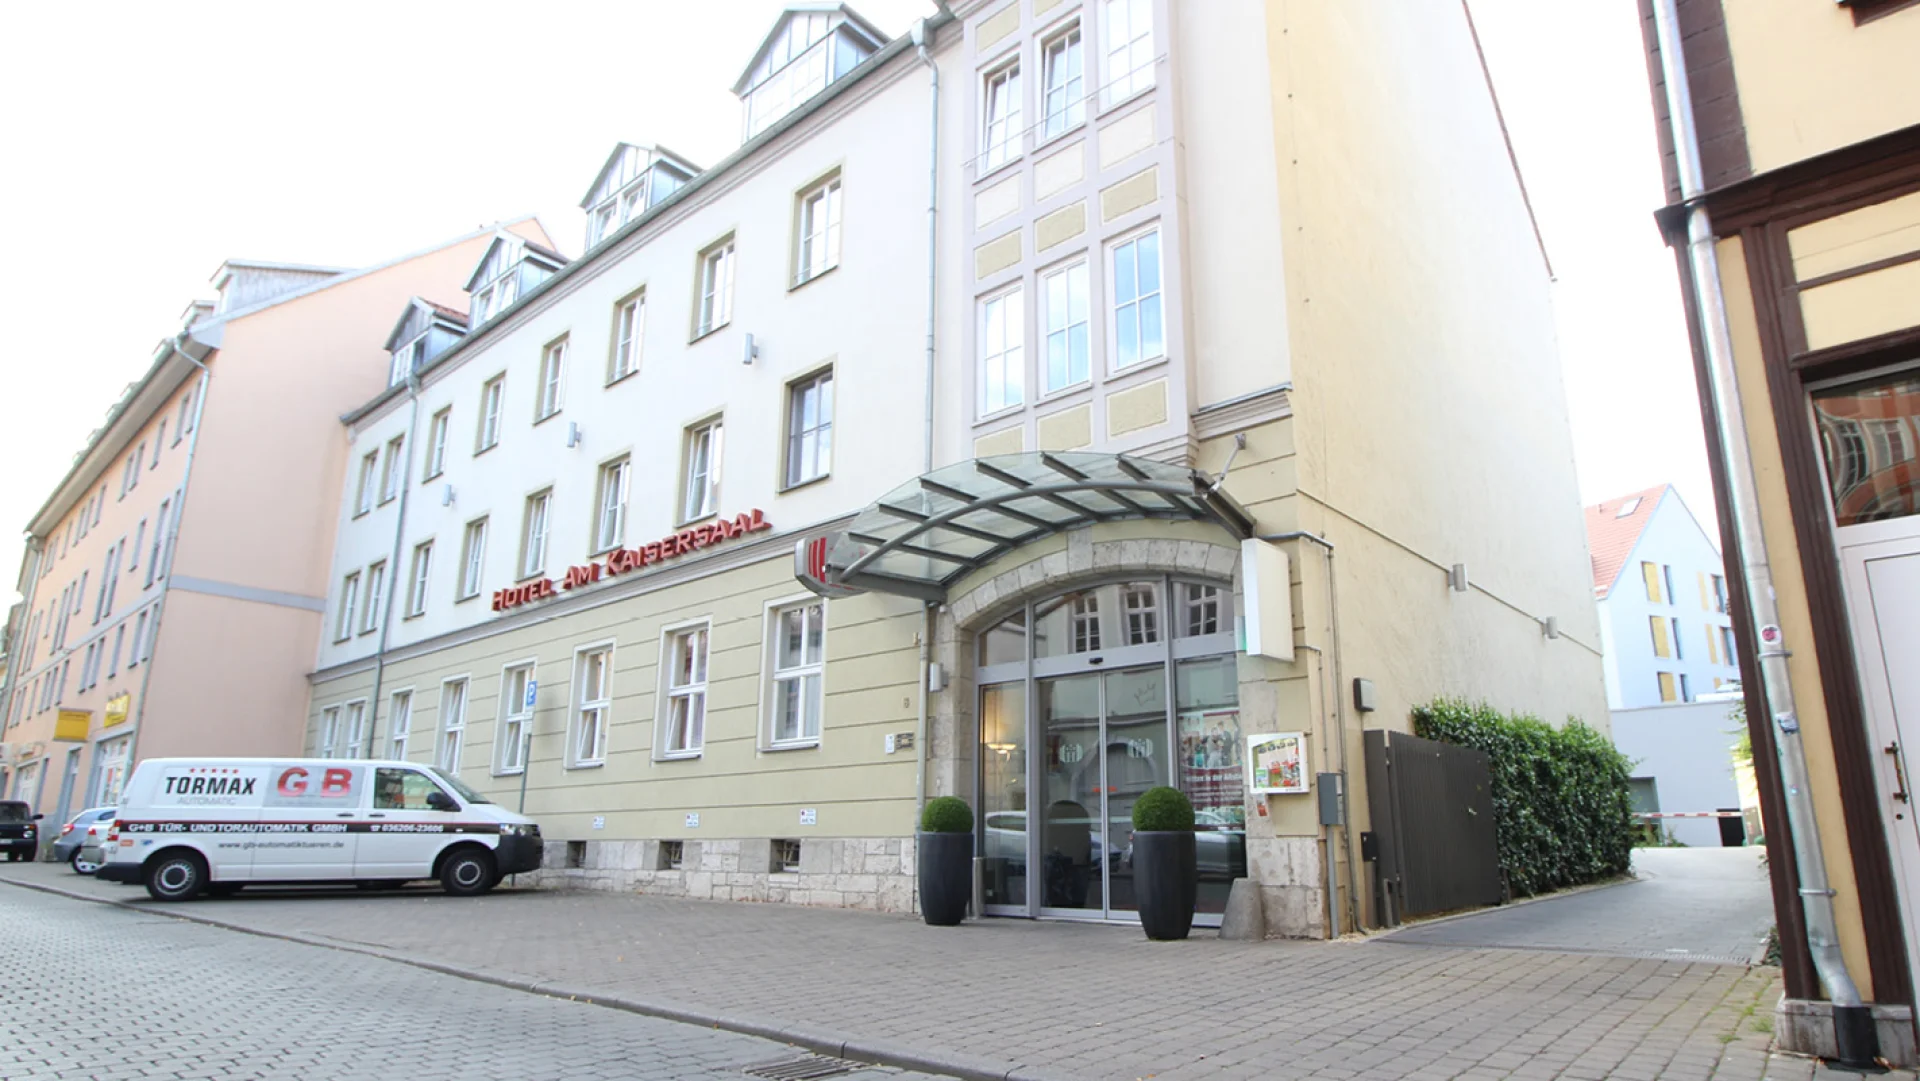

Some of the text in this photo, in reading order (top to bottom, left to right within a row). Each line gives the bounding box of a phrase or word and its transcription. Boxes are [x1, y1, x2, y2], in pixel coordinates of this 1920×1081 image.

[492, 508, 773, 611] HOTEL AM KAISERSAAL
[165, 776, 257, 795] TORMAX
[277, 766, 352, 798] G B
[128, 822, 347, 833] G+B TÜR- UND TORAUTOMATIK GMBH
